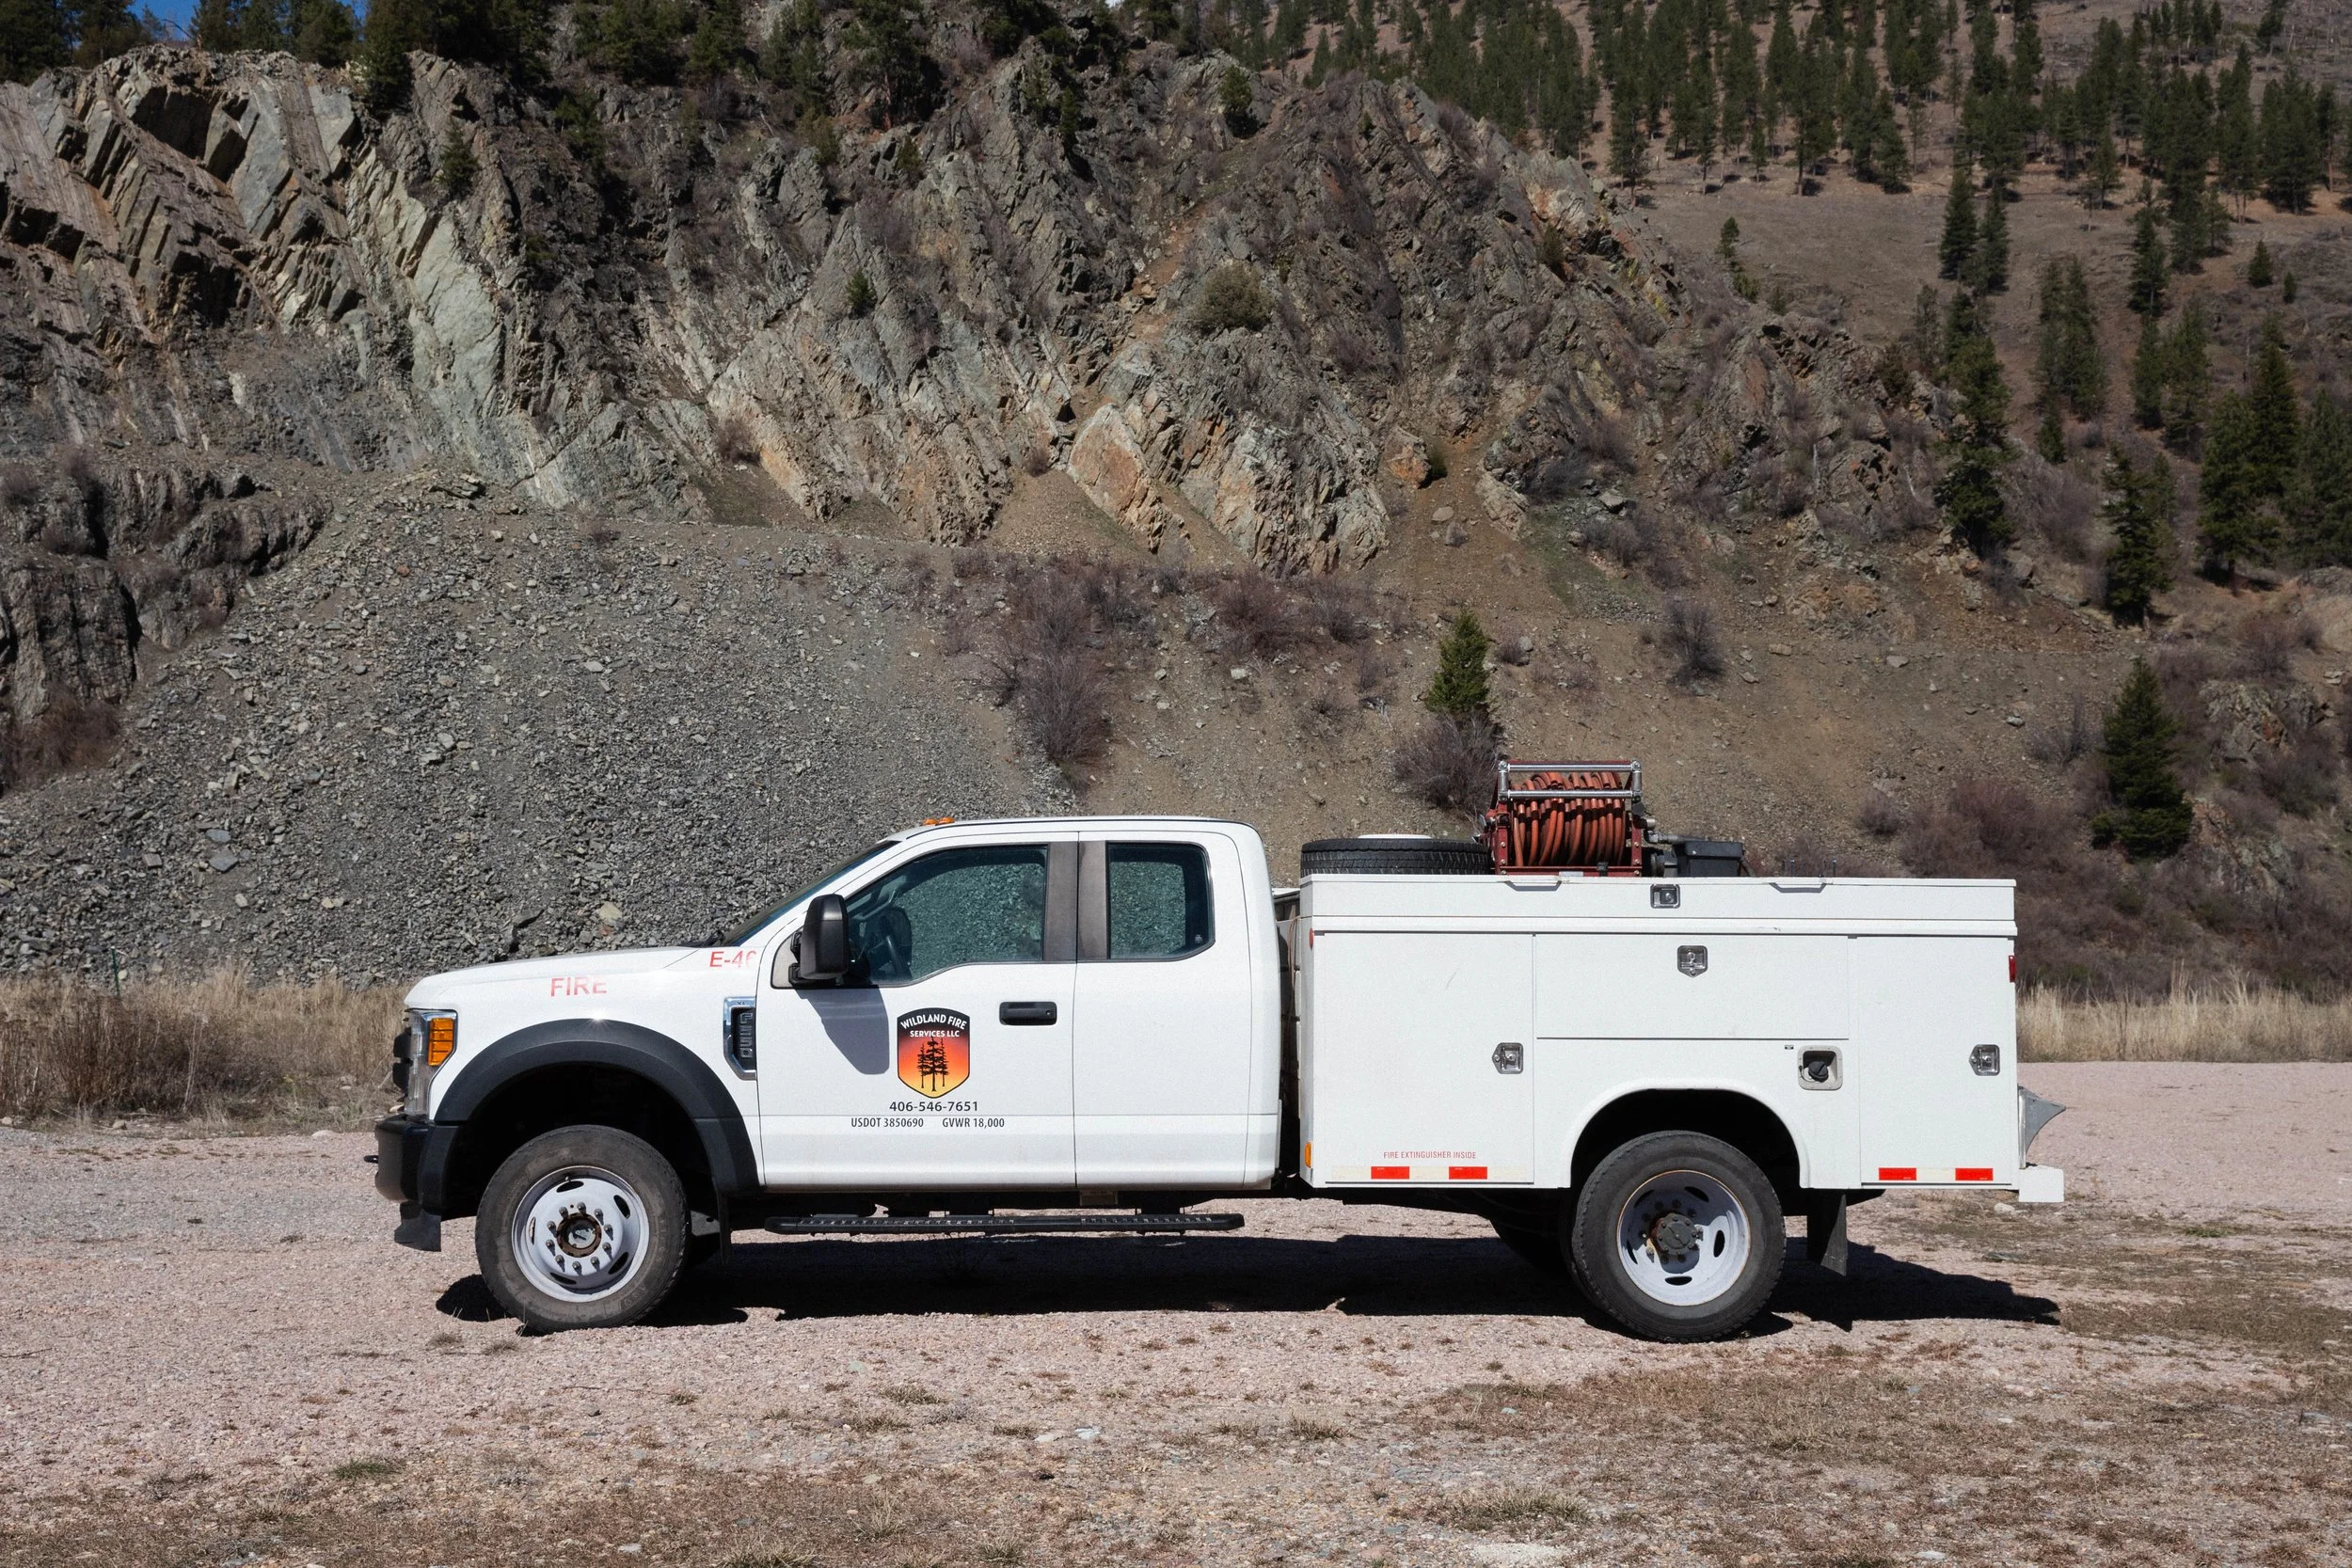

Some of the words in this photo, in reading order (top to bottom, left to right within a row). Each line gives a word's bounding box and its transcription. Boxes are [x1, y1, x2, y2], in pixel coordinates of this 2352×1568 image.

[550, 976, 607, 997] FIRE
[900, 1014, 946, 1029] WILDLAND
[947, 1016, 967, 1030] FIRE
[889, 1101, 978, 1112] 406-546-7651
[850, 1117, 882, 1128] USDOT
[883, 1117, 924, 1128] 3850690
[942, 1117, 971, 1128] GVWR
[973, 1117, 1005, 1129] 18,000
